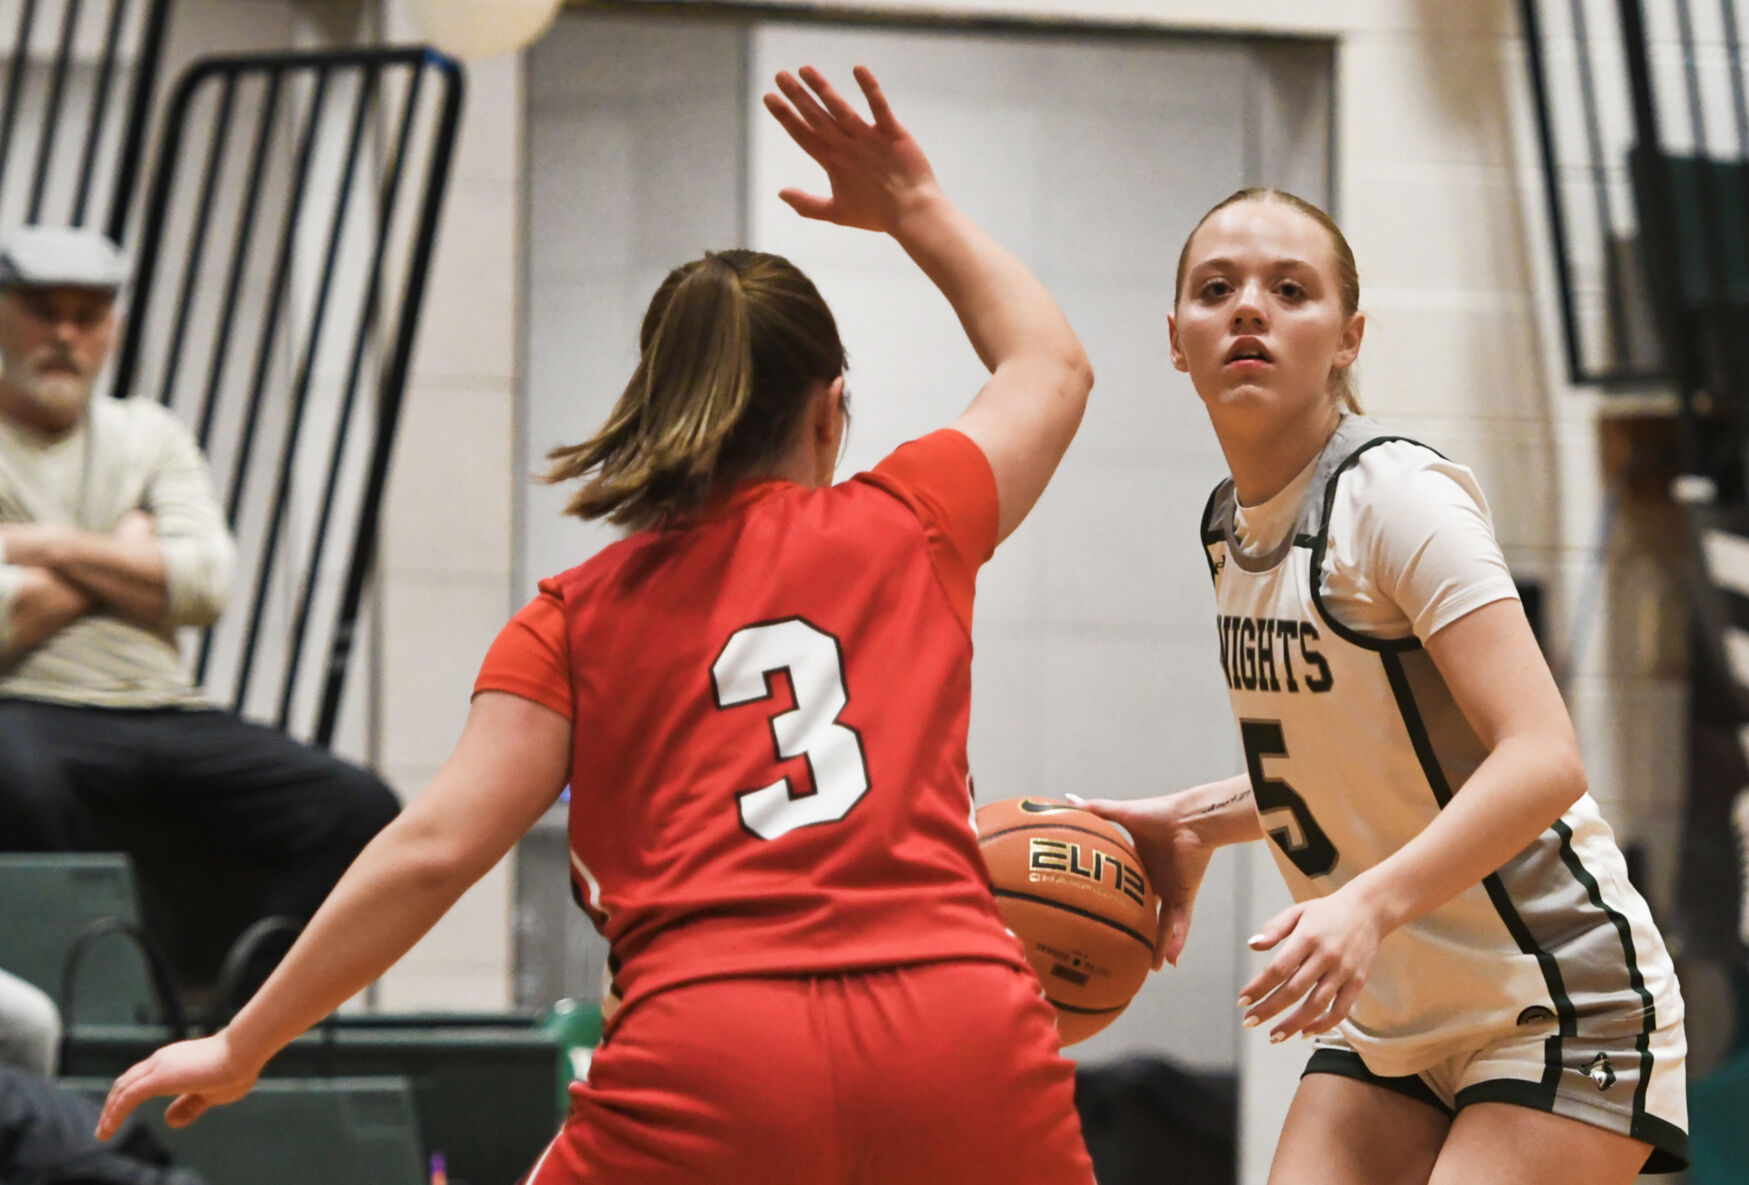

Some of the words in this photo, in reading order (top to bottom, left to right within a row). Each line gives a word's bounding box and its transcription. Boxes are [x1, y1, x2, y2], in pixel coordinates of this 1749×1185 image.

[1217, 614, 1334, 694] NIGHTS
[709, 614, 872, 841] 3
[1239, 717, 1340, 880] 5
[1029, 837, 1146, 907] ELITE
